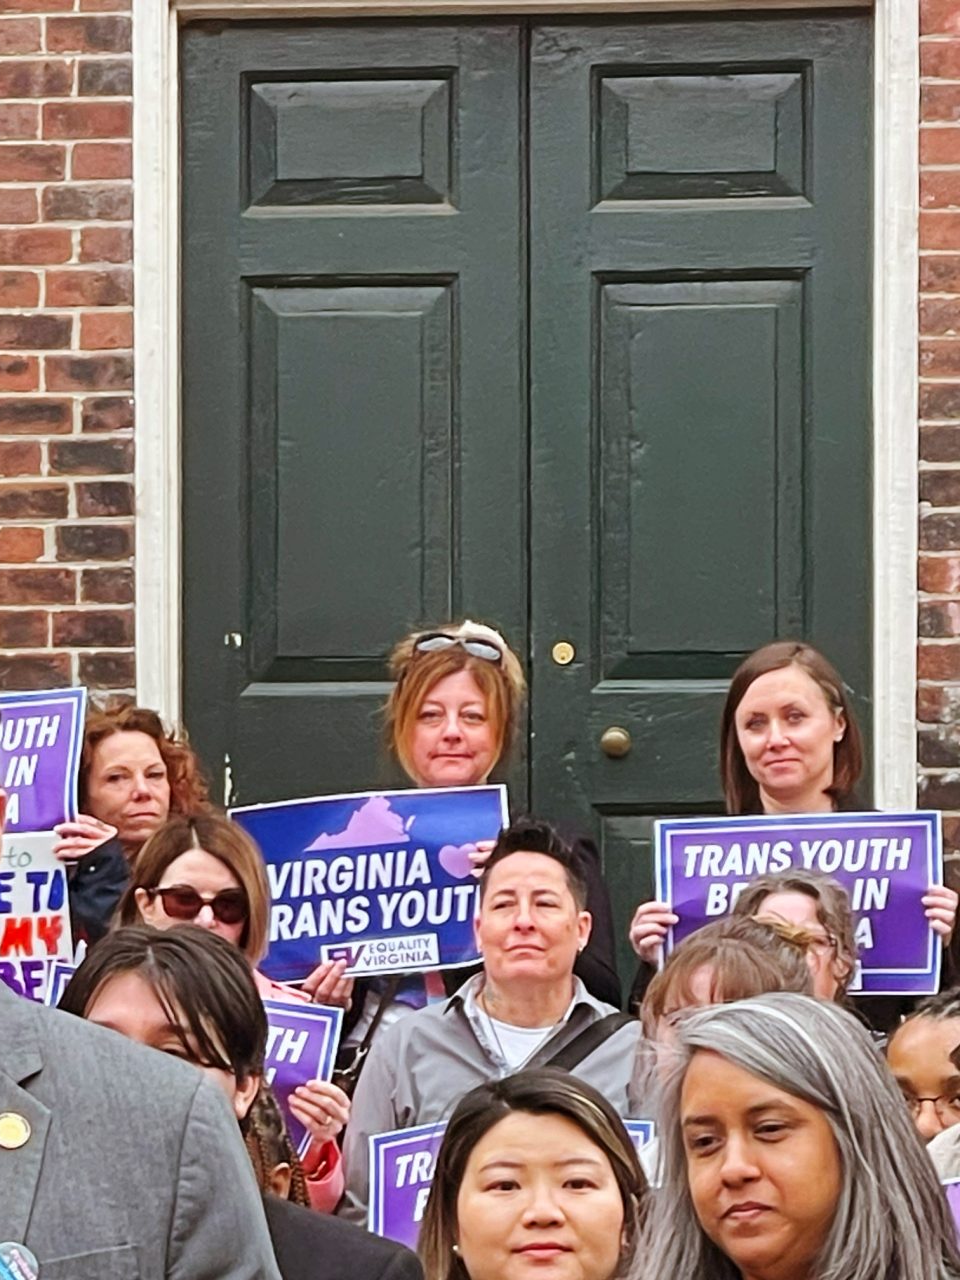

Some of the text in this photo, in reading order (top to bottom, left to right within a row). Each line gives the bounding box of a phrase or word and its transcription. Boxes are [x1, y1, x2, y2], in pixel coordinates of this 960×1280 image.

[4, 754, 38, 788] IN
[3, 847, 32, 868] to
[267, 848, 431, 899] VIRGINIA
[684, 837, 912, 878] TRANS YOUTH
[26, 868, 64, 912] TO
[851, 877, 889, 911] IN
[269, 895, 370, 942] RANS
[363, 950, 433, 967] VIRGINIA
[369, 938, 431, 954] EQUALITY
[265, 1024, 309, 1064] TH
